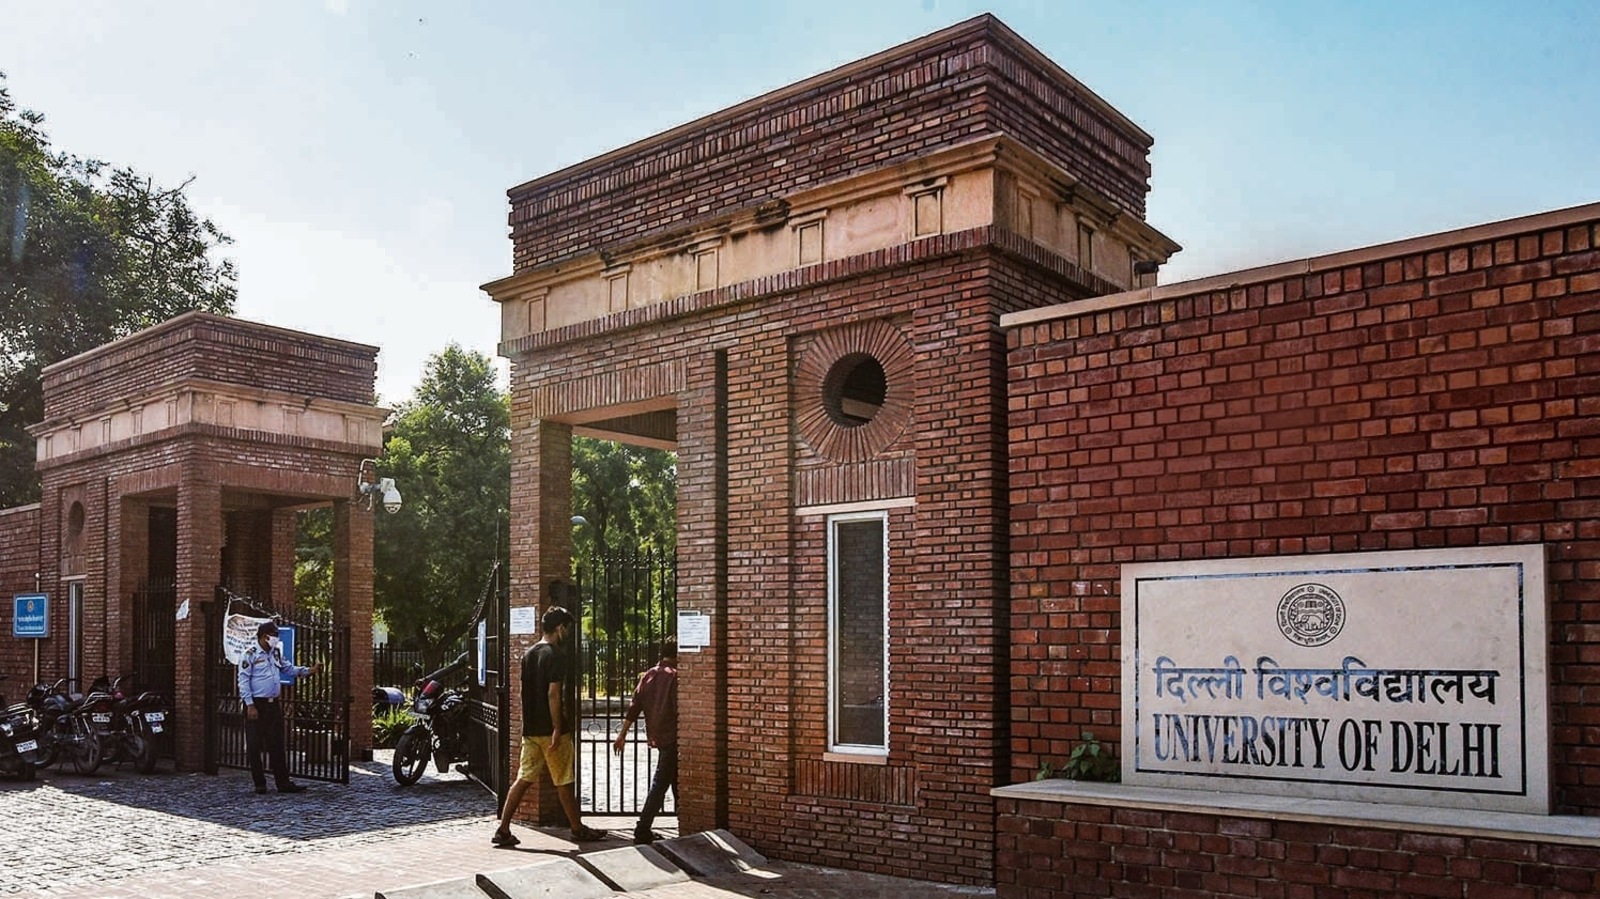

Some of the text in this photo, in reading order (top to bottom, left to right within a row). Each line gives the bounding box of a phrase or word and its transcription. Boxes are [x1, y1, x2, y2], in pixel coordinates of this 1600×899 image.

[1152, 655, 1501, 705] दिल्ली विश्वविद्यालय
[1153, 713, 1503, 778] UNIVERSITY OF DELHI
